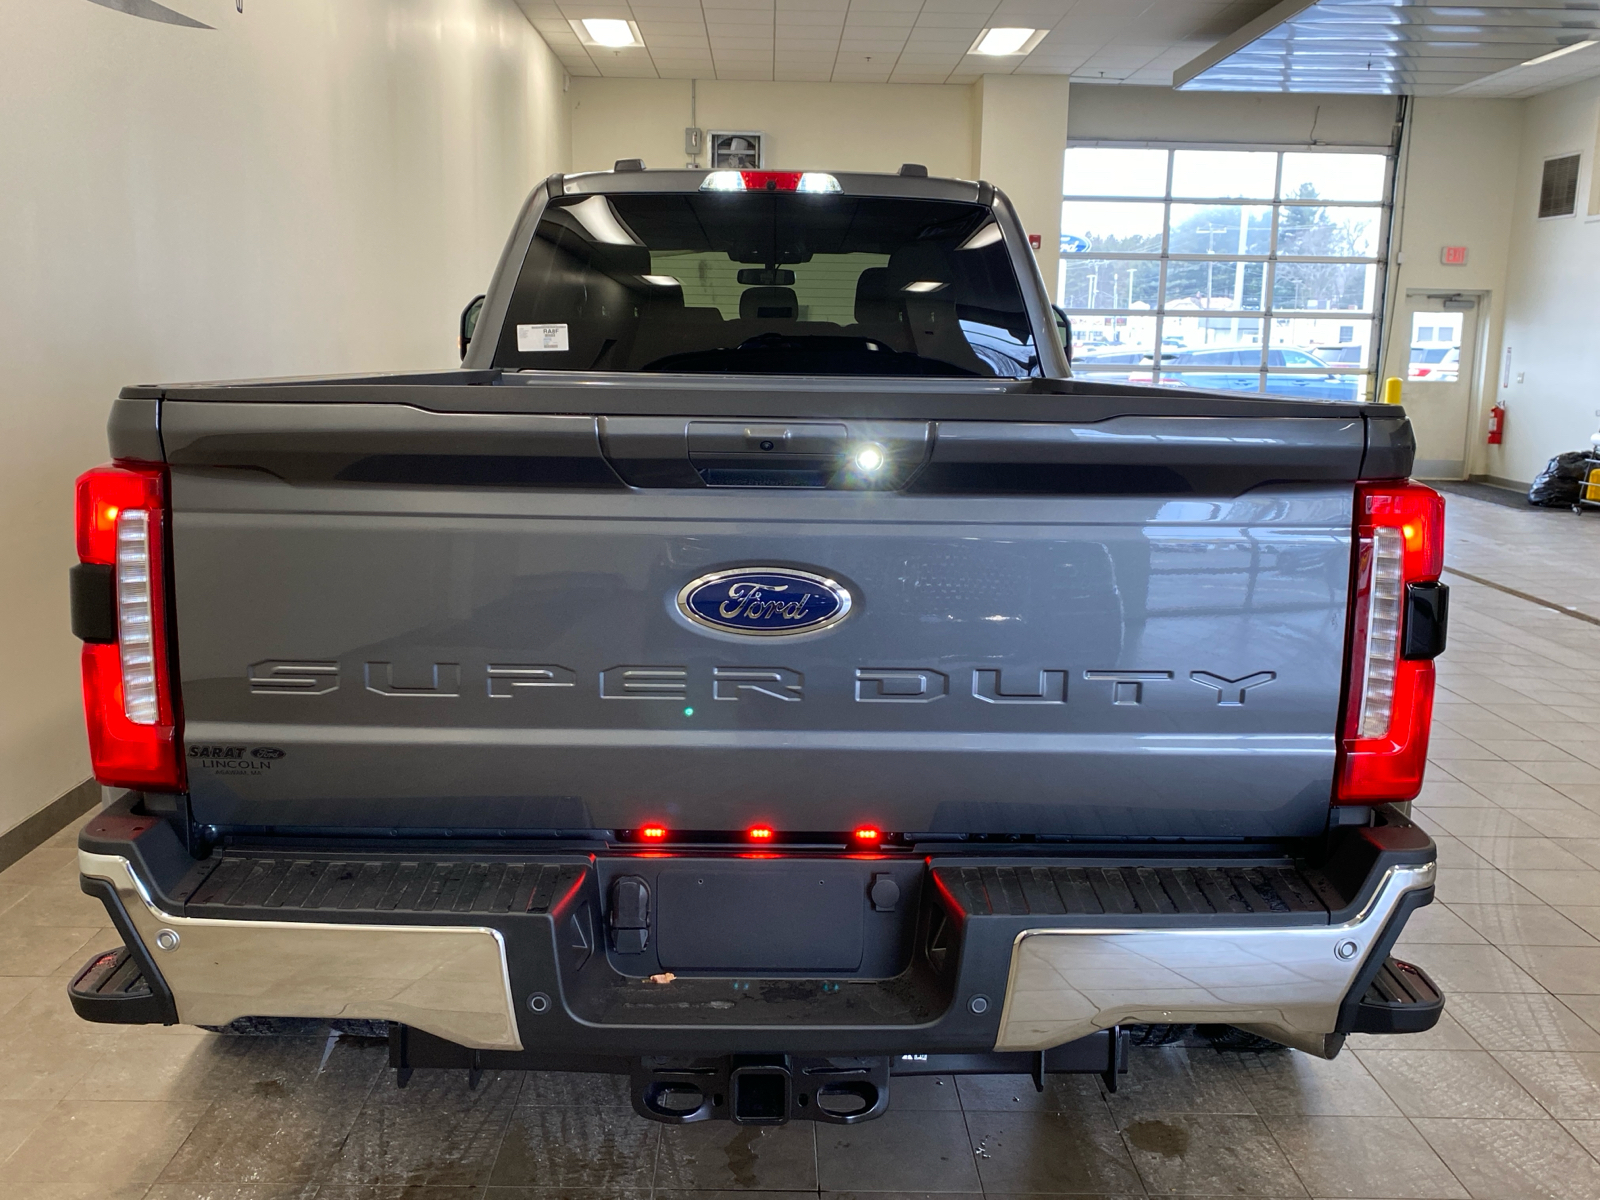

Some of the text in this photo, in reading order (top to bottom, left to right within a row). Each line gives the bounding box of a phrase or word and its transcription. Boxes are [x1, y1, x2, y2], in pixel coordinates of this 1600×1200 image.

[719, 582, 809, 619] Ford
[247, 659, 1278, 706] SUPER DUTY
[188, 745, 247, 759] SARAT
[202, 760, 271, 769] LINCOLN
